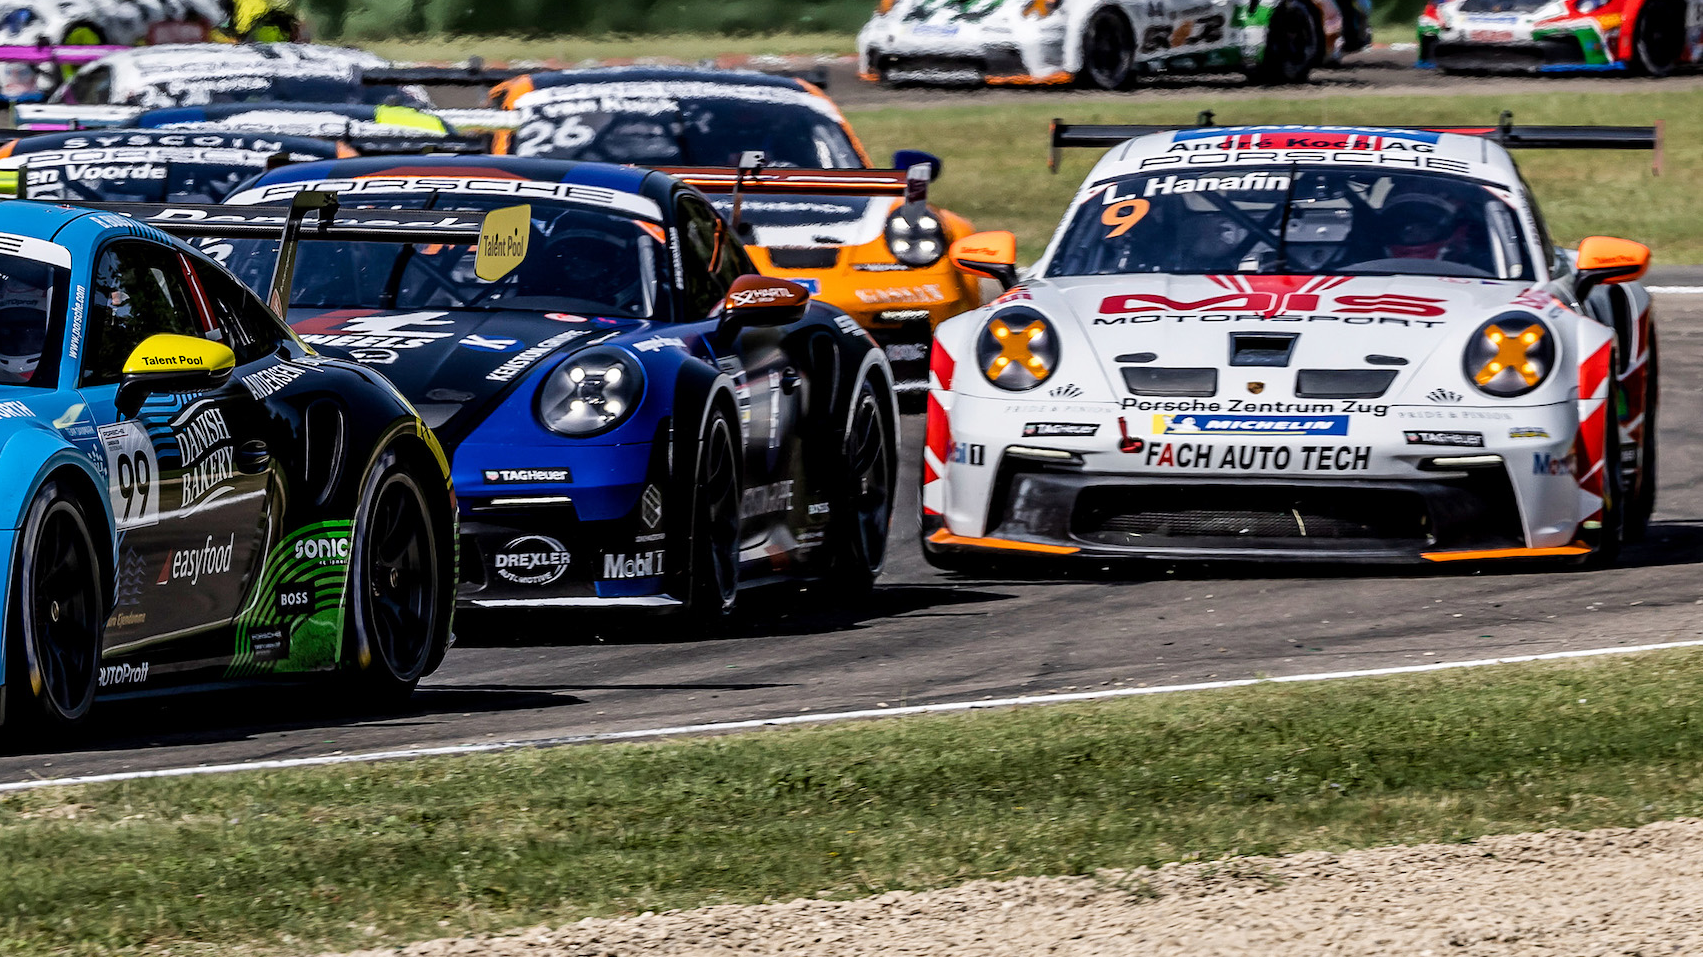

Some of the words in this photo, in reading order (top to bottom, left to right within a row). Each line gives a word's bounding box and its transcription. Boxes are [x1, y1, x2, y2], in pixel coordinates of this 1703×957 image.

[63, 135, 282, 152] SYSCOIN
[516, 115, 597, 157] 26
[1167, 137, 1273, 152] André
[1286, 136, 1371, 150] Koch
[1381, 140, 1435, 153] AG
[65, 163, 169, 181] Voorde
[1140, 150, 1469, 173] PORSCHE
[262, 178, 615, 203] PORSCHE
[1143, 170, 1290, 198] Hanafin
[1100, 199, 1151, 239] 9
[483, 235, 506, 258] Talent
[508, 235, 524, 257] Pool
[68, 284, 86, 359] www.porsche.com
[1093, 314, 1447, 329] MOTORSPORT
[141, 355, 178, 366] Talent
[180, 355, 204, 365] Pool
[1121, 397, 1221, 413] Porsche
[1228, 399, 1334, 413] Zentrum
[1341, 400, 1389, 417] Zug
[1203, 419, 1336, 431] MICHELIN
[175, 407, 232, 468] DANISH
[1144, 442, 1212, 469] FACH
[1218, 445, 1291, 470] AUTO
[1300, 446, 1373, 470] TECH
[117, 449, 151, 523] 99
[181, 445, 235, 508] BAKERY
[171, 531, 235, 586] easyfood
[495, 551, 571, 570] DREXLER
[280, 591, 309, 607] BOSS
